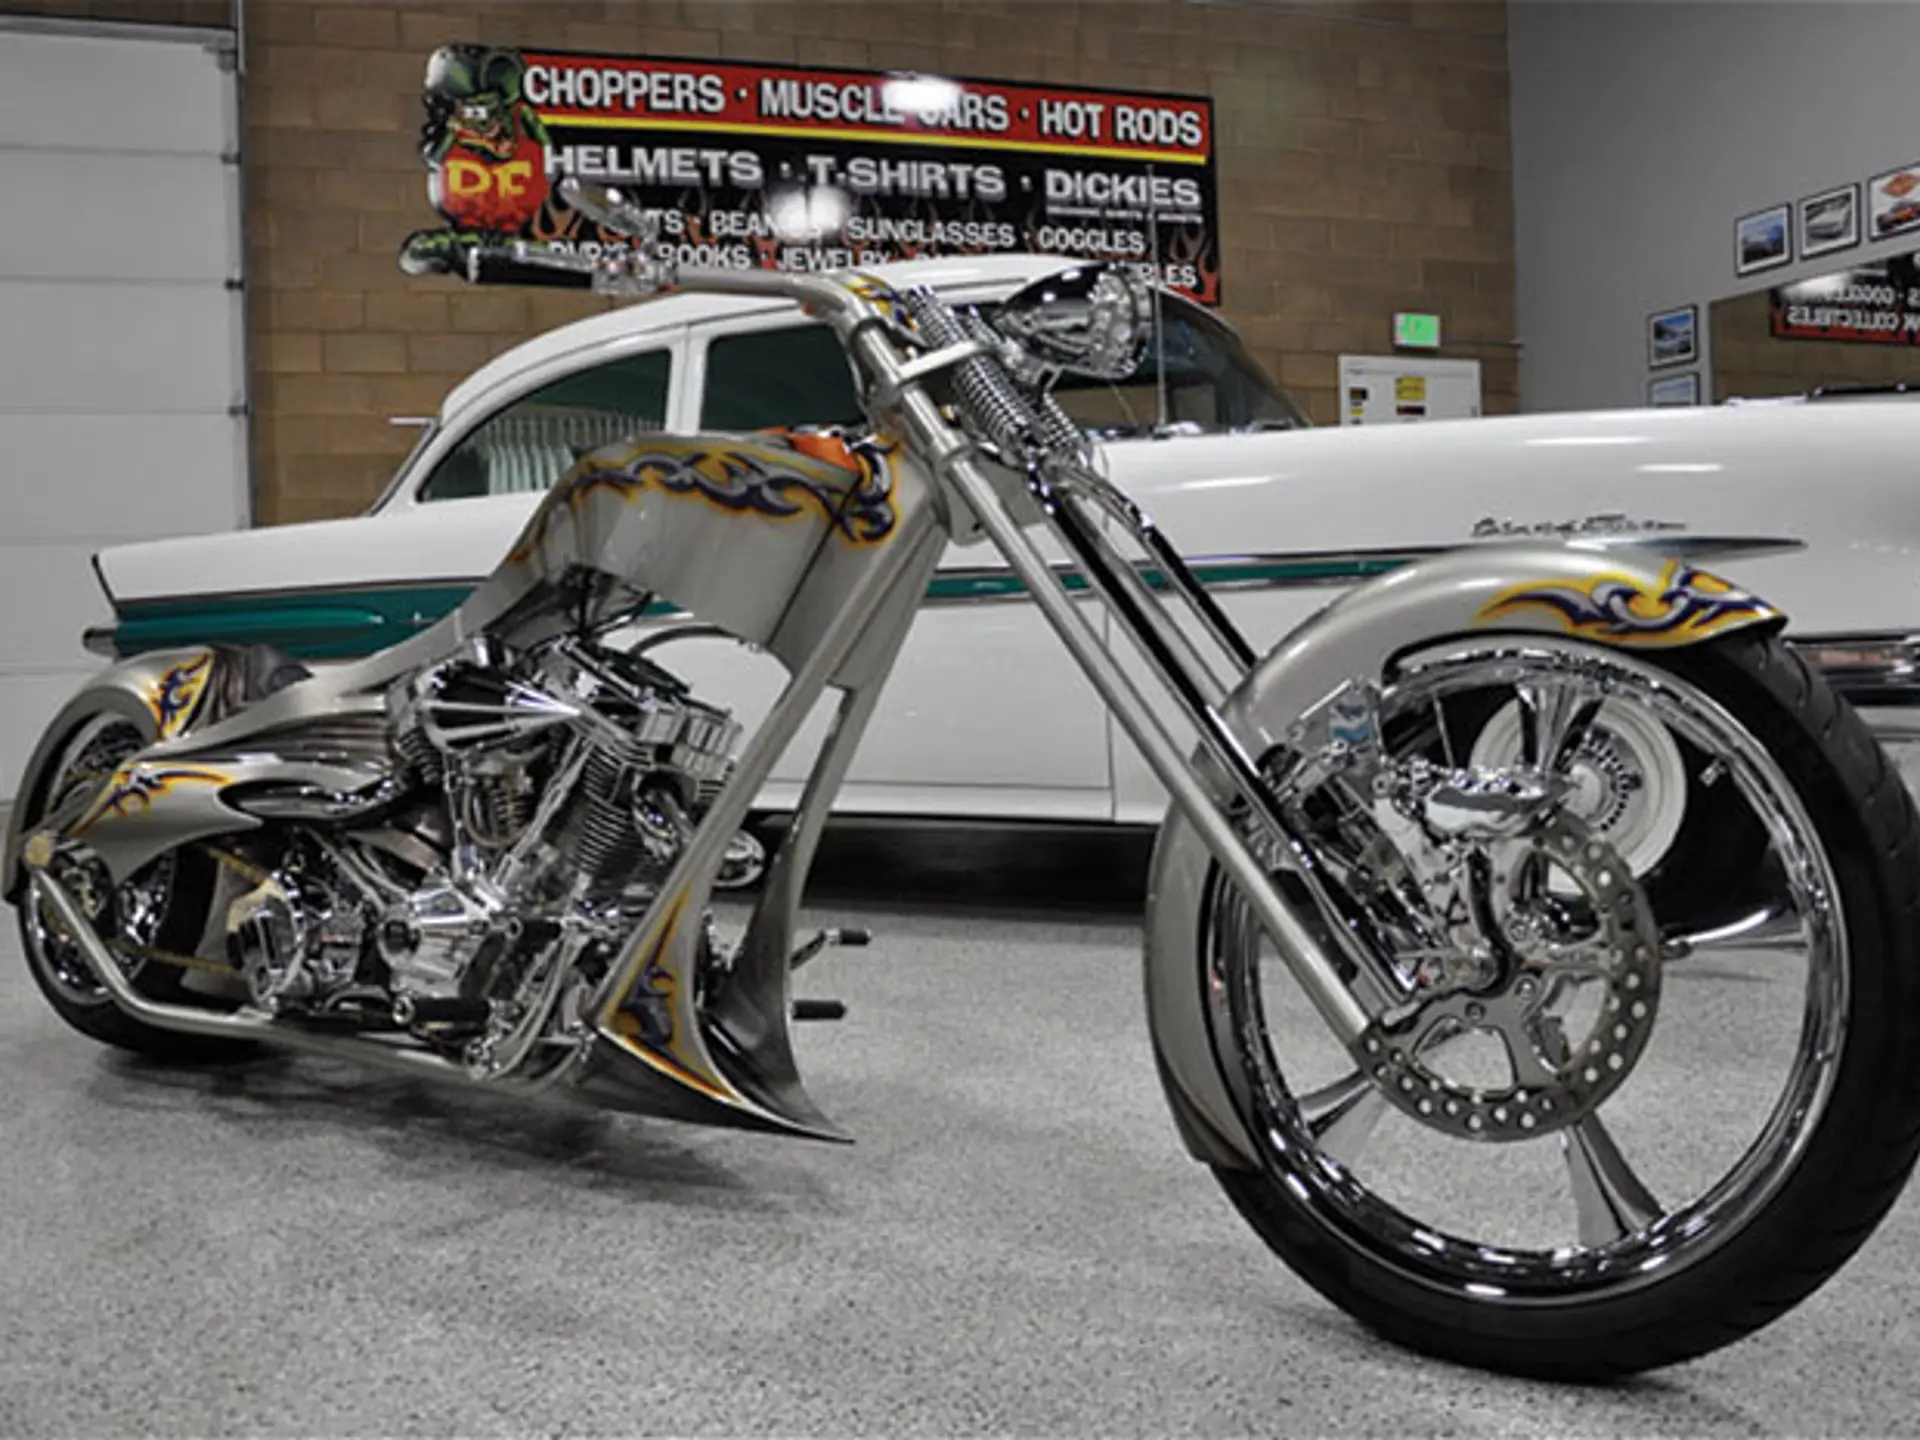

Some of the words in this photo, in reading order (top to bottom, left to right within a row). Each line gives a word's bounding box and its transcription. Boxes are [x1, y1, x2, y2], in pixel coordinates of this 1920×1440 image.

[523, 65, 726, 113] CHOPPERS
[1040, 99, 1105, 138] HOT
[1115, 104, 1203, 147] RODS
[544, 144, 763, 186] HELMETS
[1046, 169, 1201, 208] DICKIES
[709, 210, 824, 240] BEAN
[848, 216, 1016, 248] SUNGLASSES
[1039, 226, 1144, 255] GOGGLES
